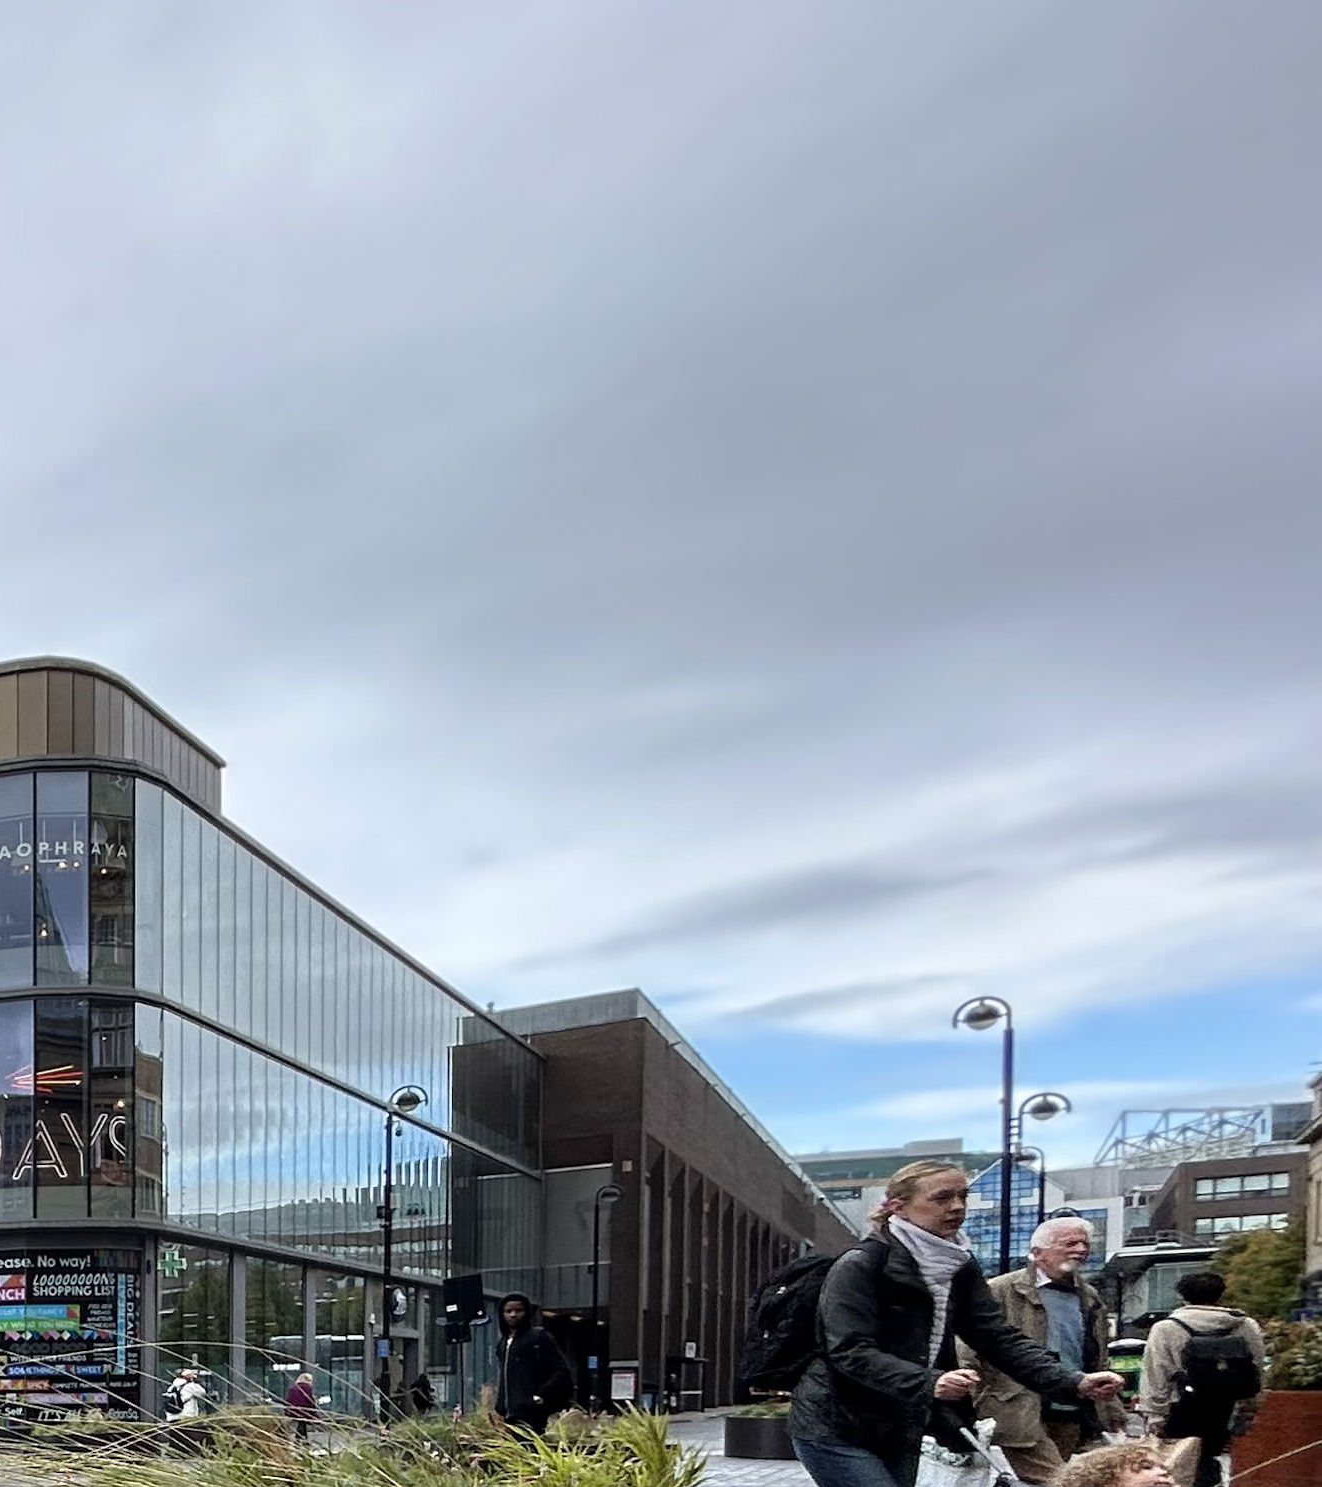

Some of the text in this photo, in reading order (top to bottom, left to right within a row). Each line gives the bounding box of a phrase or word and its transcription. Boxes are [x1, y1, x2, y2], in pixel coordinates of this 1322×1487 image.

[37, 1255, 56, 1268] No
[59, 1255, 91, 1270] way!
[32, 1284, 115, 1297] SHOPPING LIST
